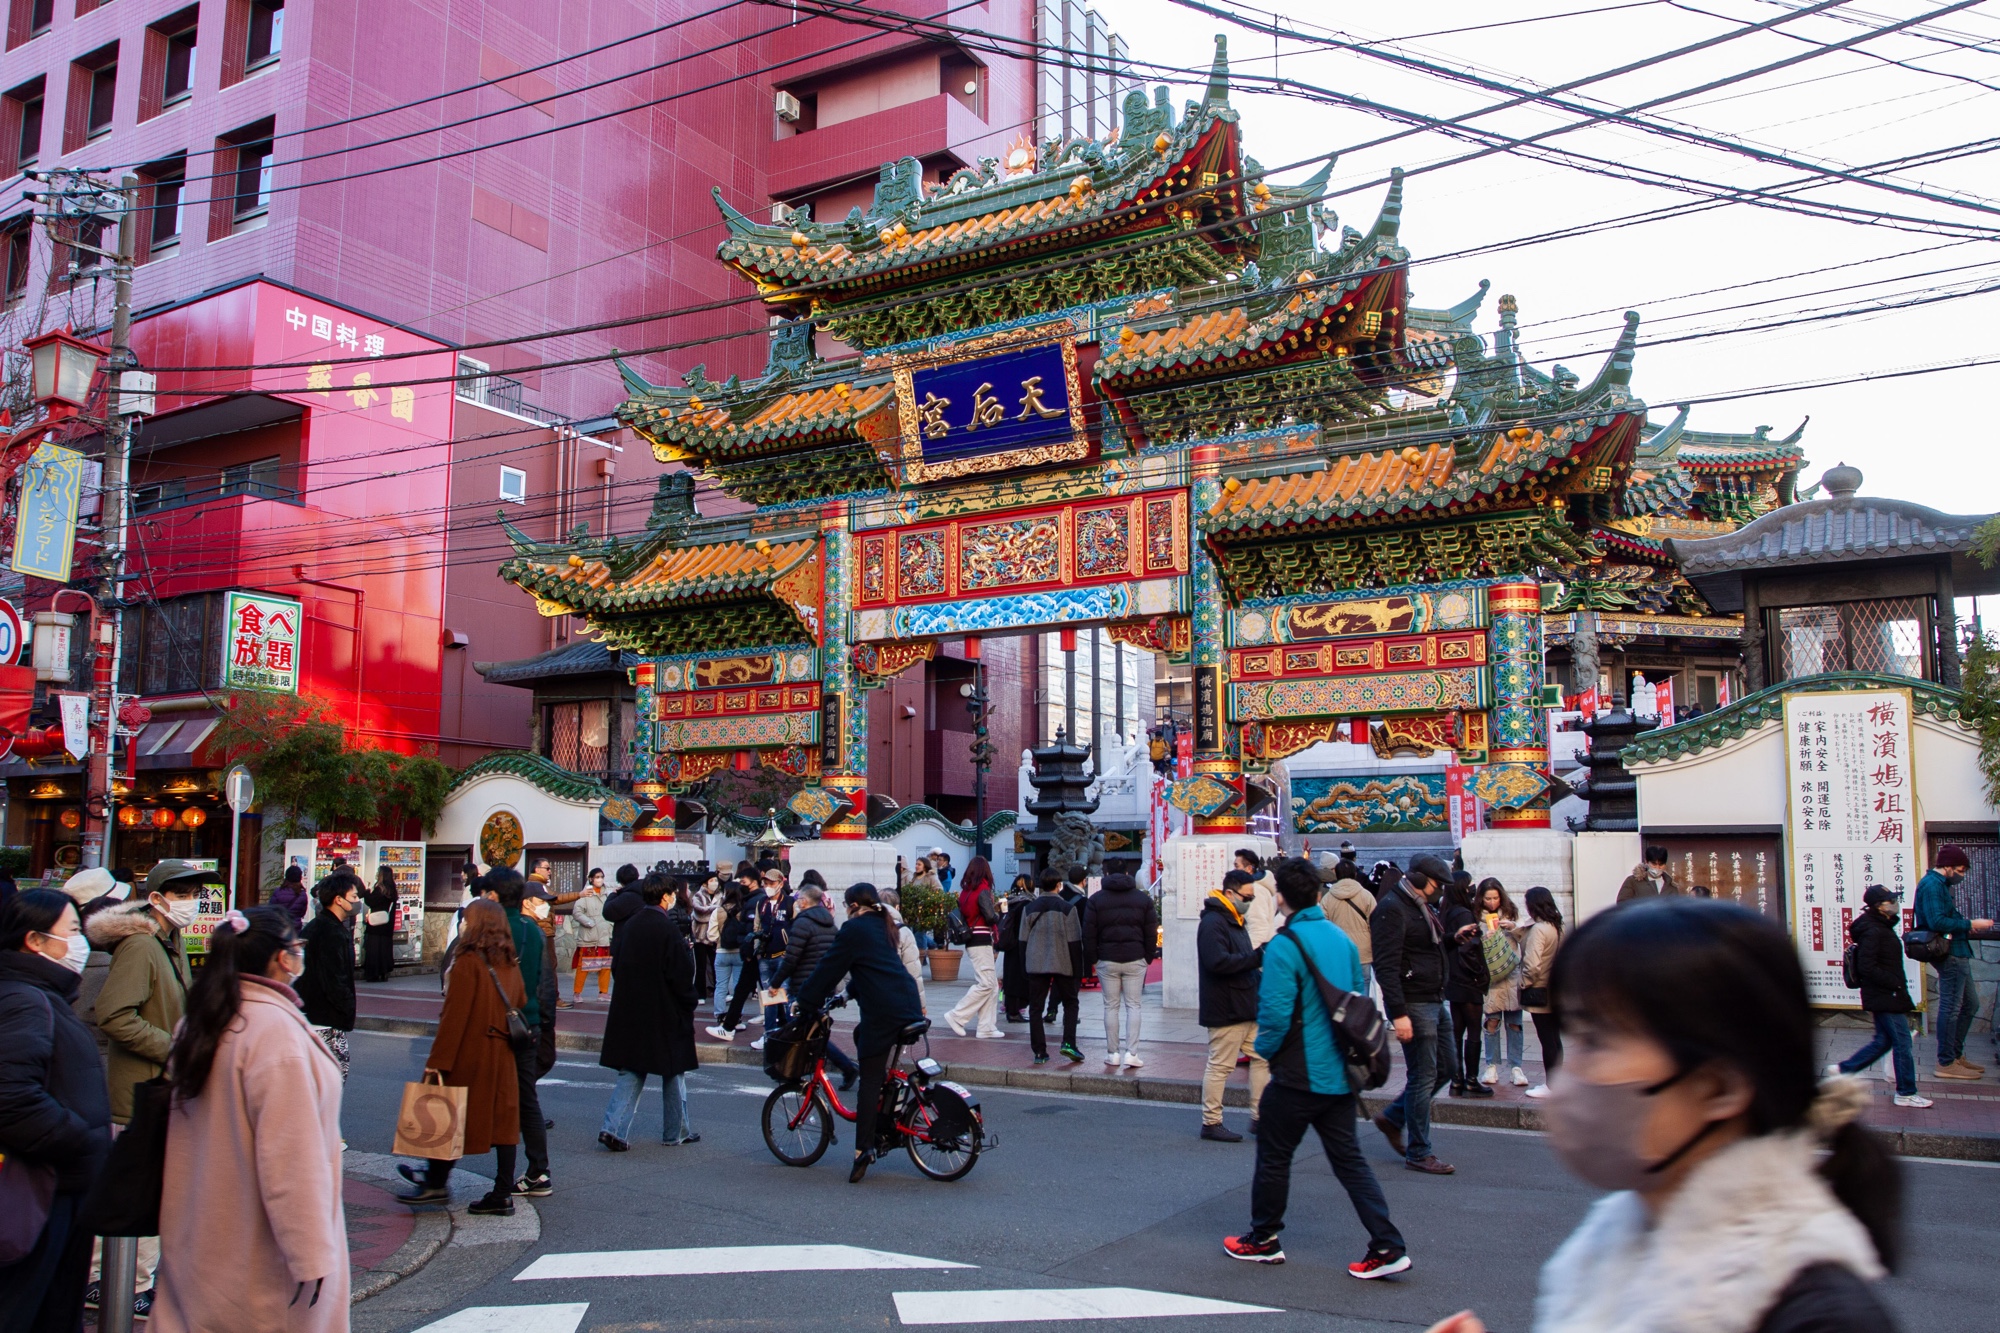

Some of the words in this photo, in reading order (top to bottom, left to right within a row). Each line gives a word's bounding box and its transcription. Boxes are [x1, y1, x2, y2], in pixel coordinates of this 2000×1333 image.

[286, 306, 385, 358] 中国料理
[237, 603, 294, 636] 食べ
[232, 669, 291, 687] 時間無制限
[234, 635, 294, 671] 放題
[1798, 722, 1813, 772] 健康祈願
[1814, 721, 1829, 772] 家内安全
[1866, 701, 1905, 844] 横濱媽祖廟
[1801, 781, 1815, 831] 旅の安全
[1817, 781, 1831, 831] 開運厄除
[1803, 853, 1816, 904] 学問の神様
[1833, 853, 1846, 904] 縁結びの神様
[198, 901, 223, 914] 放題
